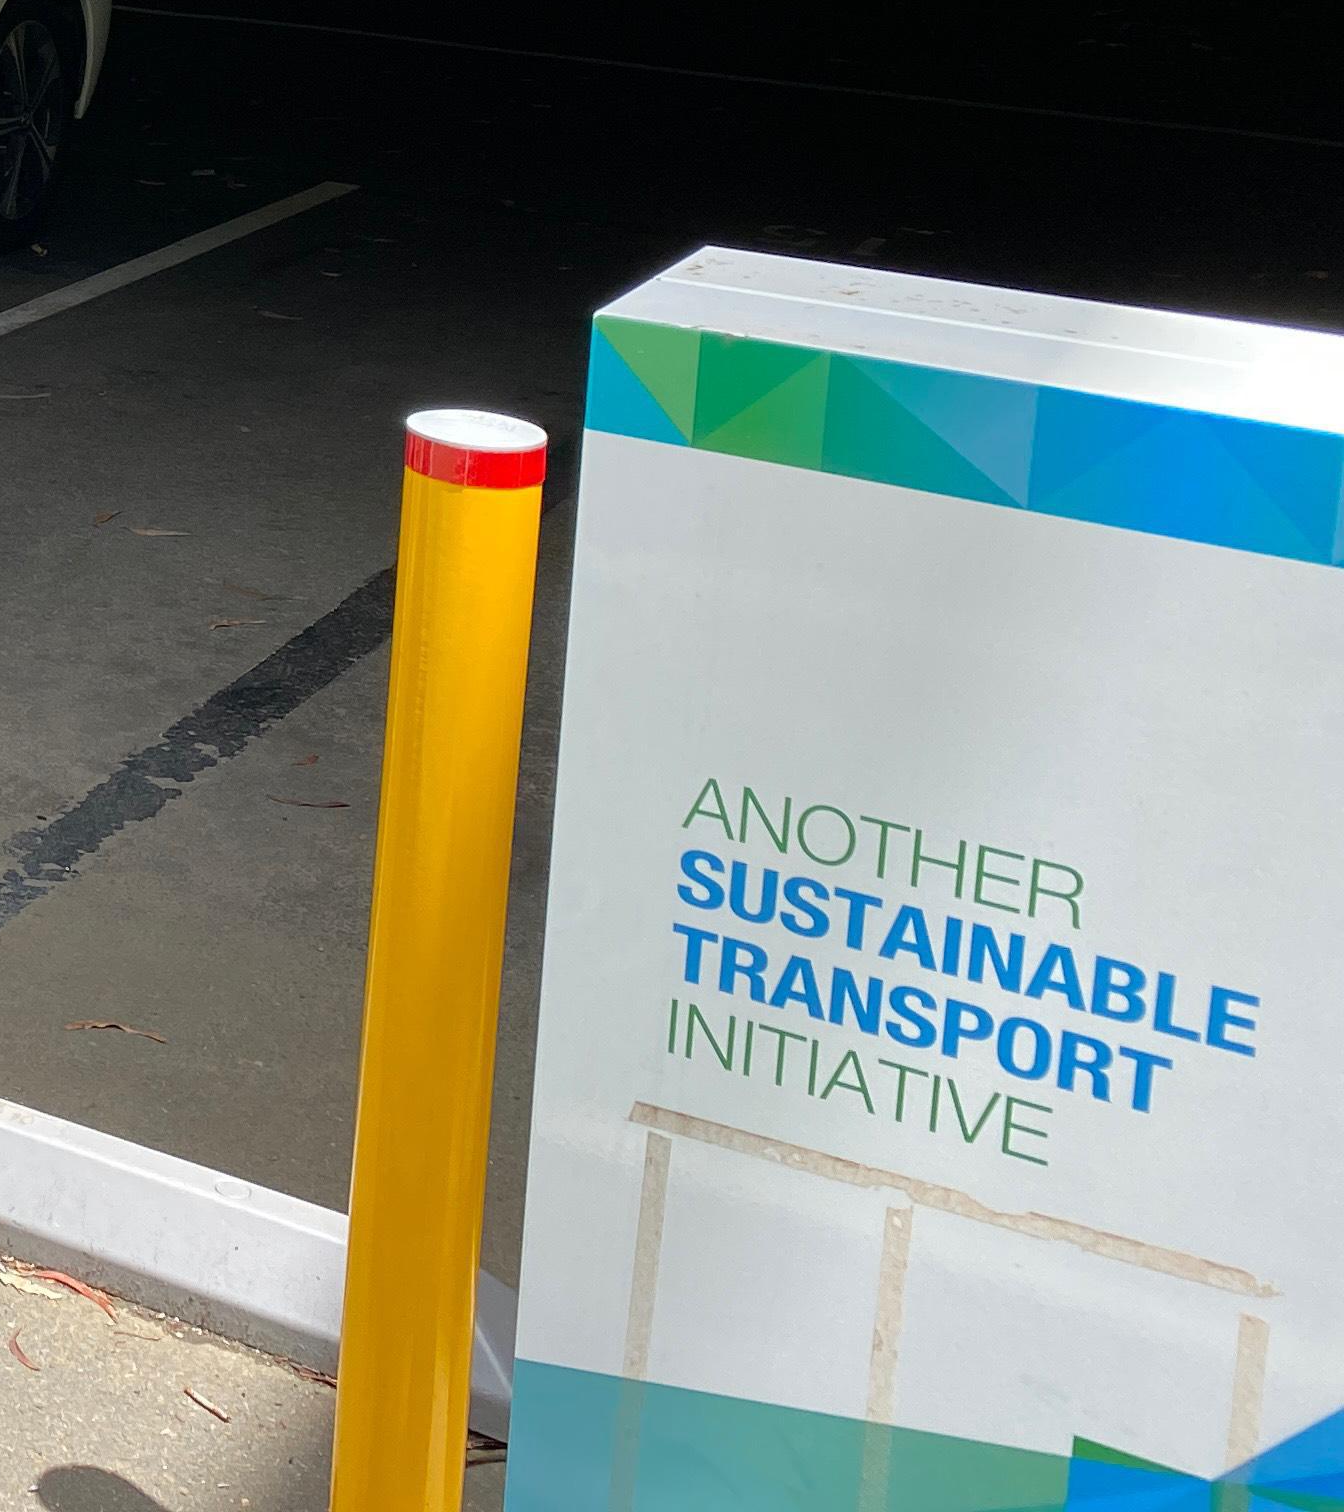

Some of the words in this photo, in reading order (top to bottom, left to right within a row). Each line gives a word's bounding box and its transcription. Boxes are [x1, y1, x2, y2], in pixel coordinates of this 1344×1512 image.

[682, 777, 1086, 930] ANOTHER
[672, 921, 1174, 1114] TRANSPORT
[676, 848, 1261, 1058] SUSTAINABLE
[666, 998, 1054, 1166] INITIATIVE
